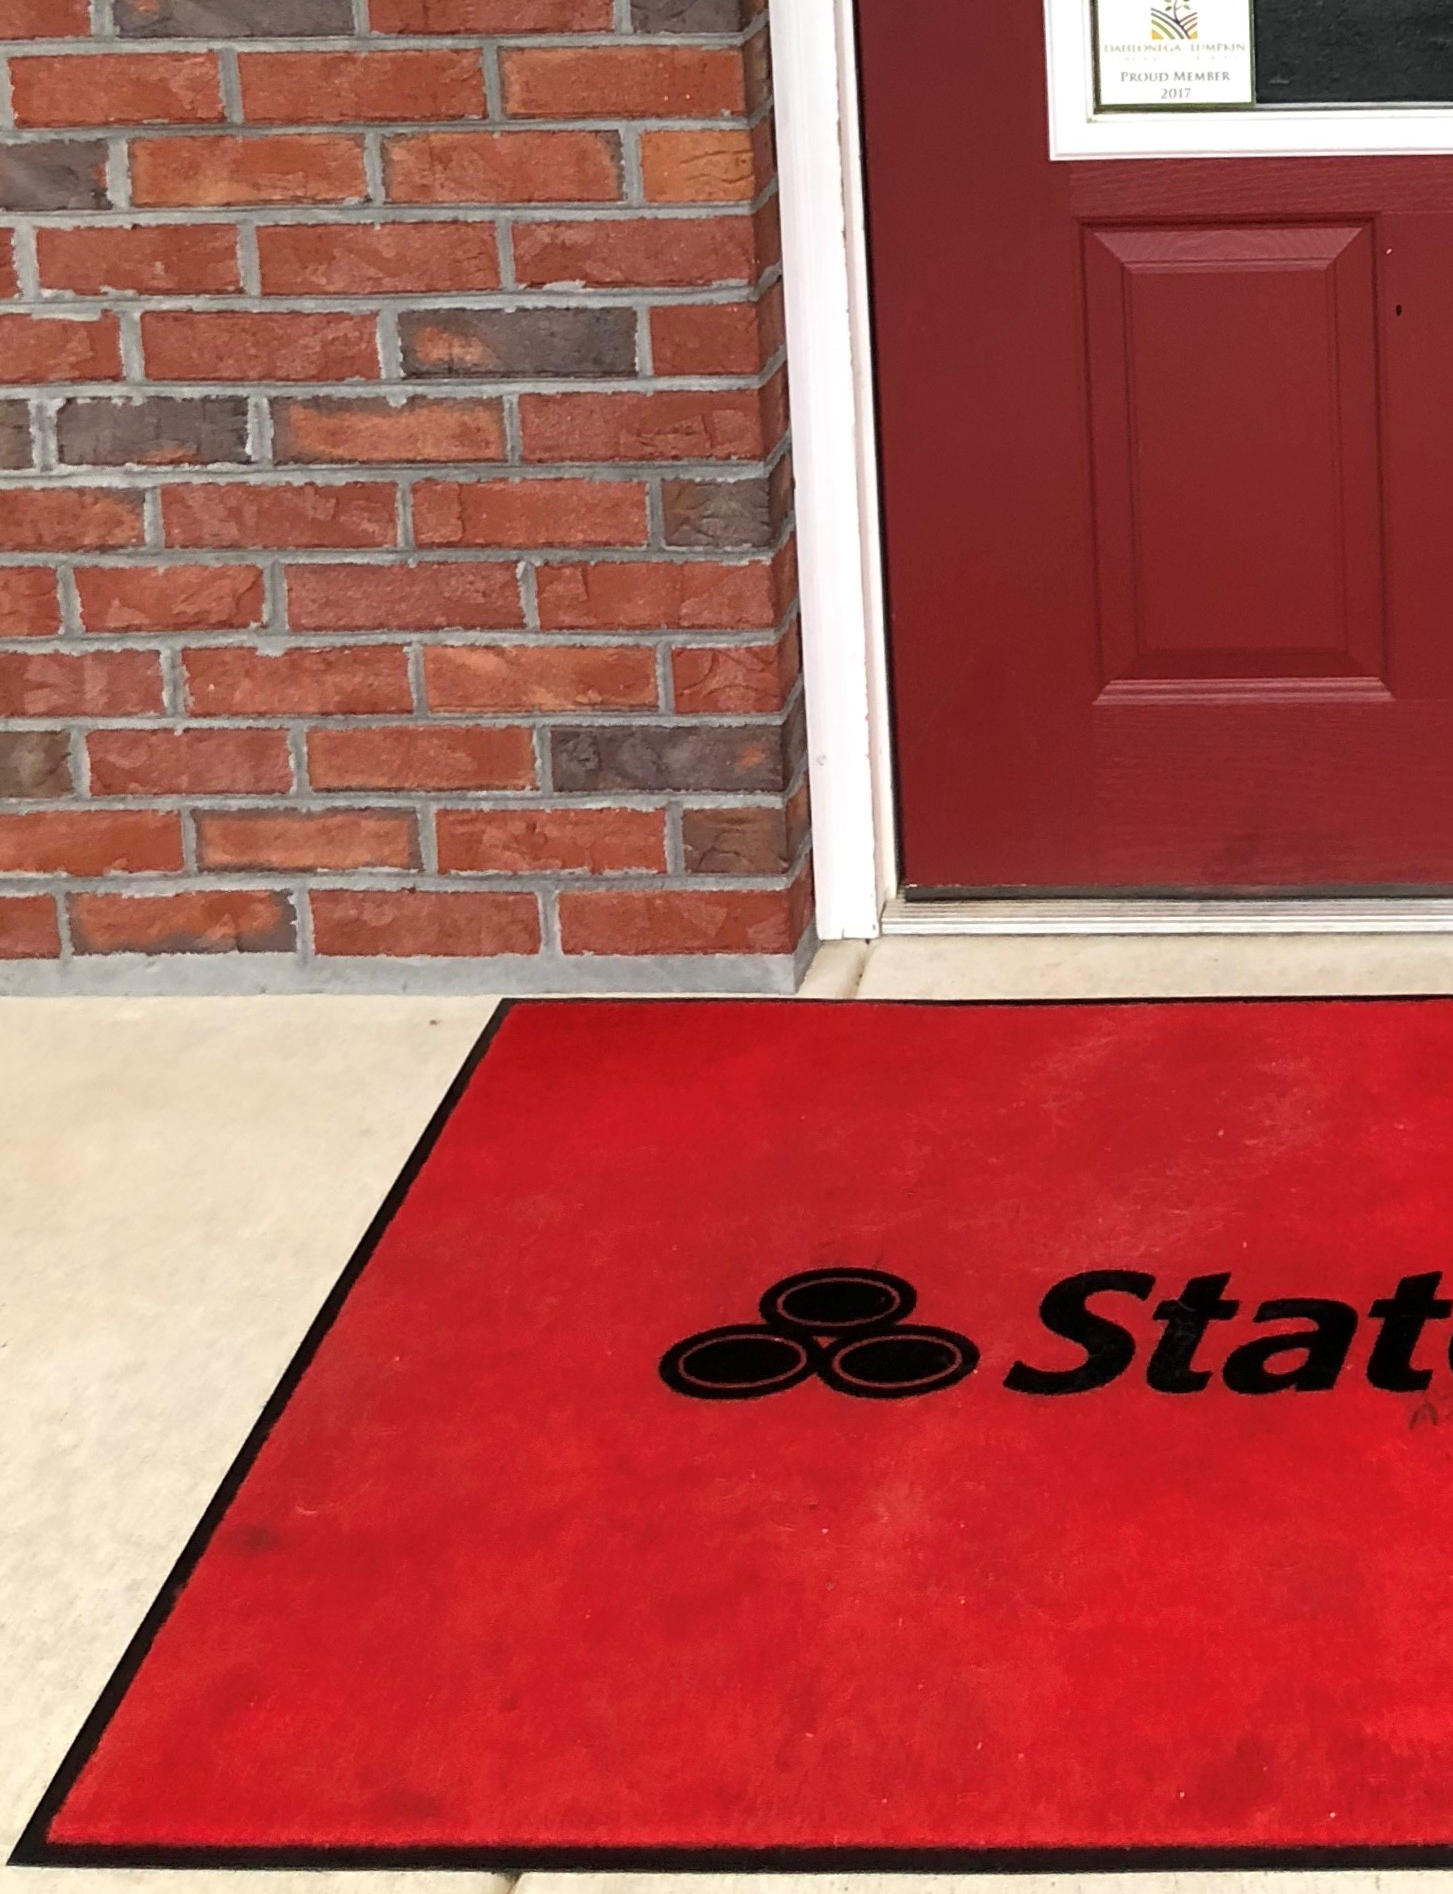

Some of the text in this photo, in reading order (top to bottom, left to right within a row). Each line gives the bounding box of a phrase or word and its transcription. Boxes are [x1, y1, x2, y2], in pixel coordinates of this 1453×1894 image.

[1120, 70, 1231, 83] PROUD MEMBER
[1160, 87, 1192, 100] 2017
